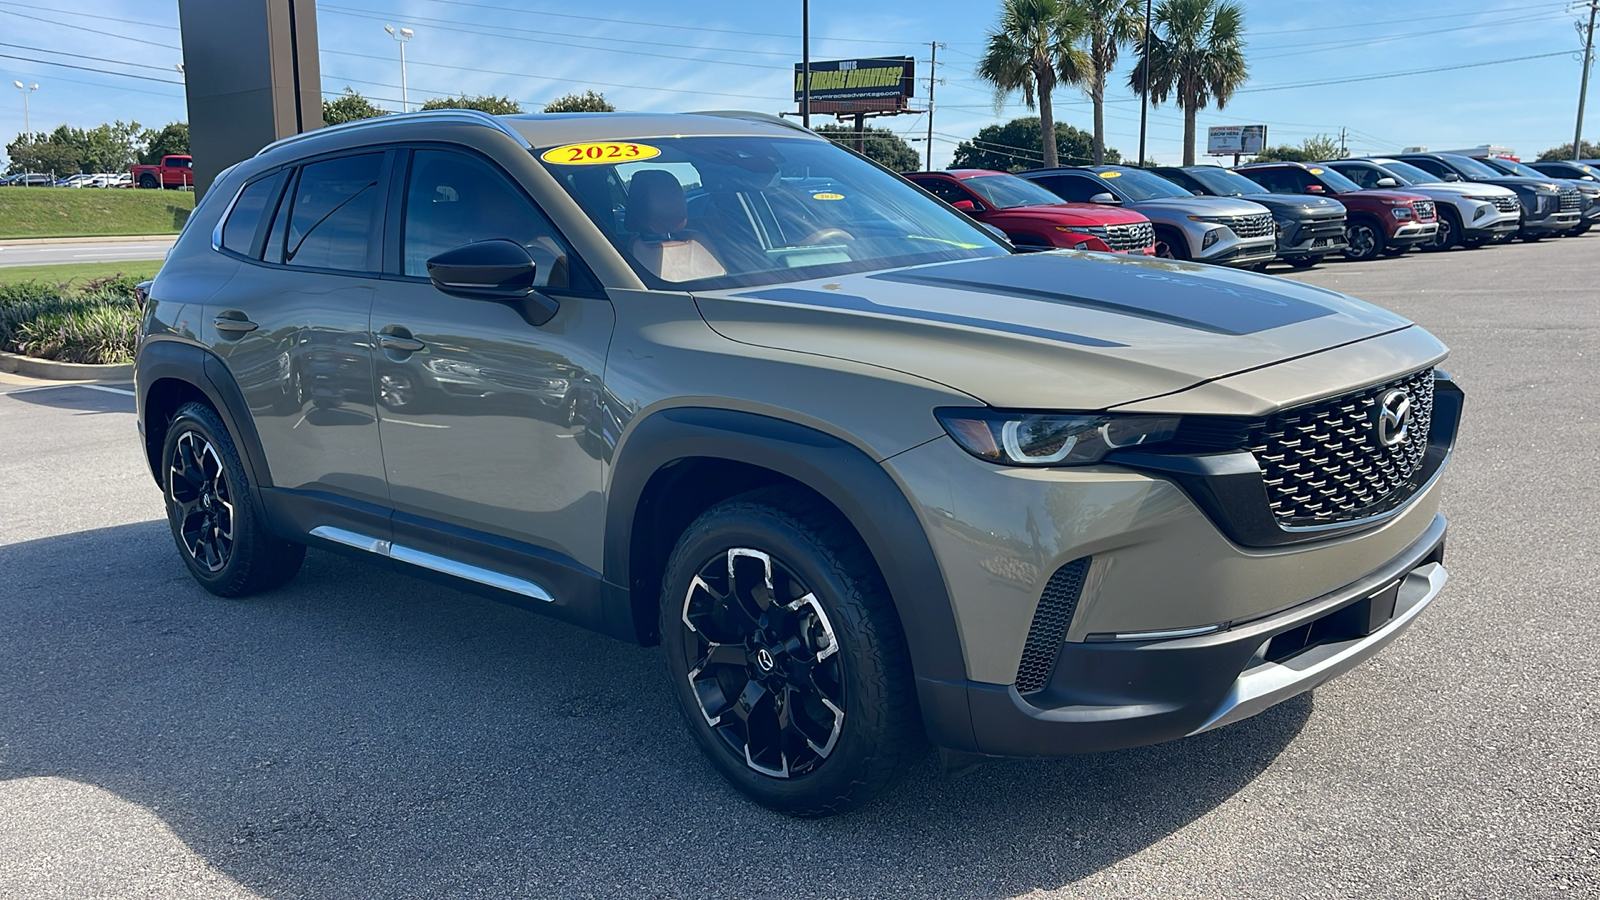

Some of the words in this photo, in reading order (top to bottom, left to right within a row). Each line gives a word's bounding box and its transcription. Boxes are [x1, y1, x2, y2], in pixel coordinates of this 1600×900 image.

[811, 70, 847, 91] MIRACLE
[845, 66, 904, 89] ADVANTAGE?
[568, 145, 641, 162] 2023
